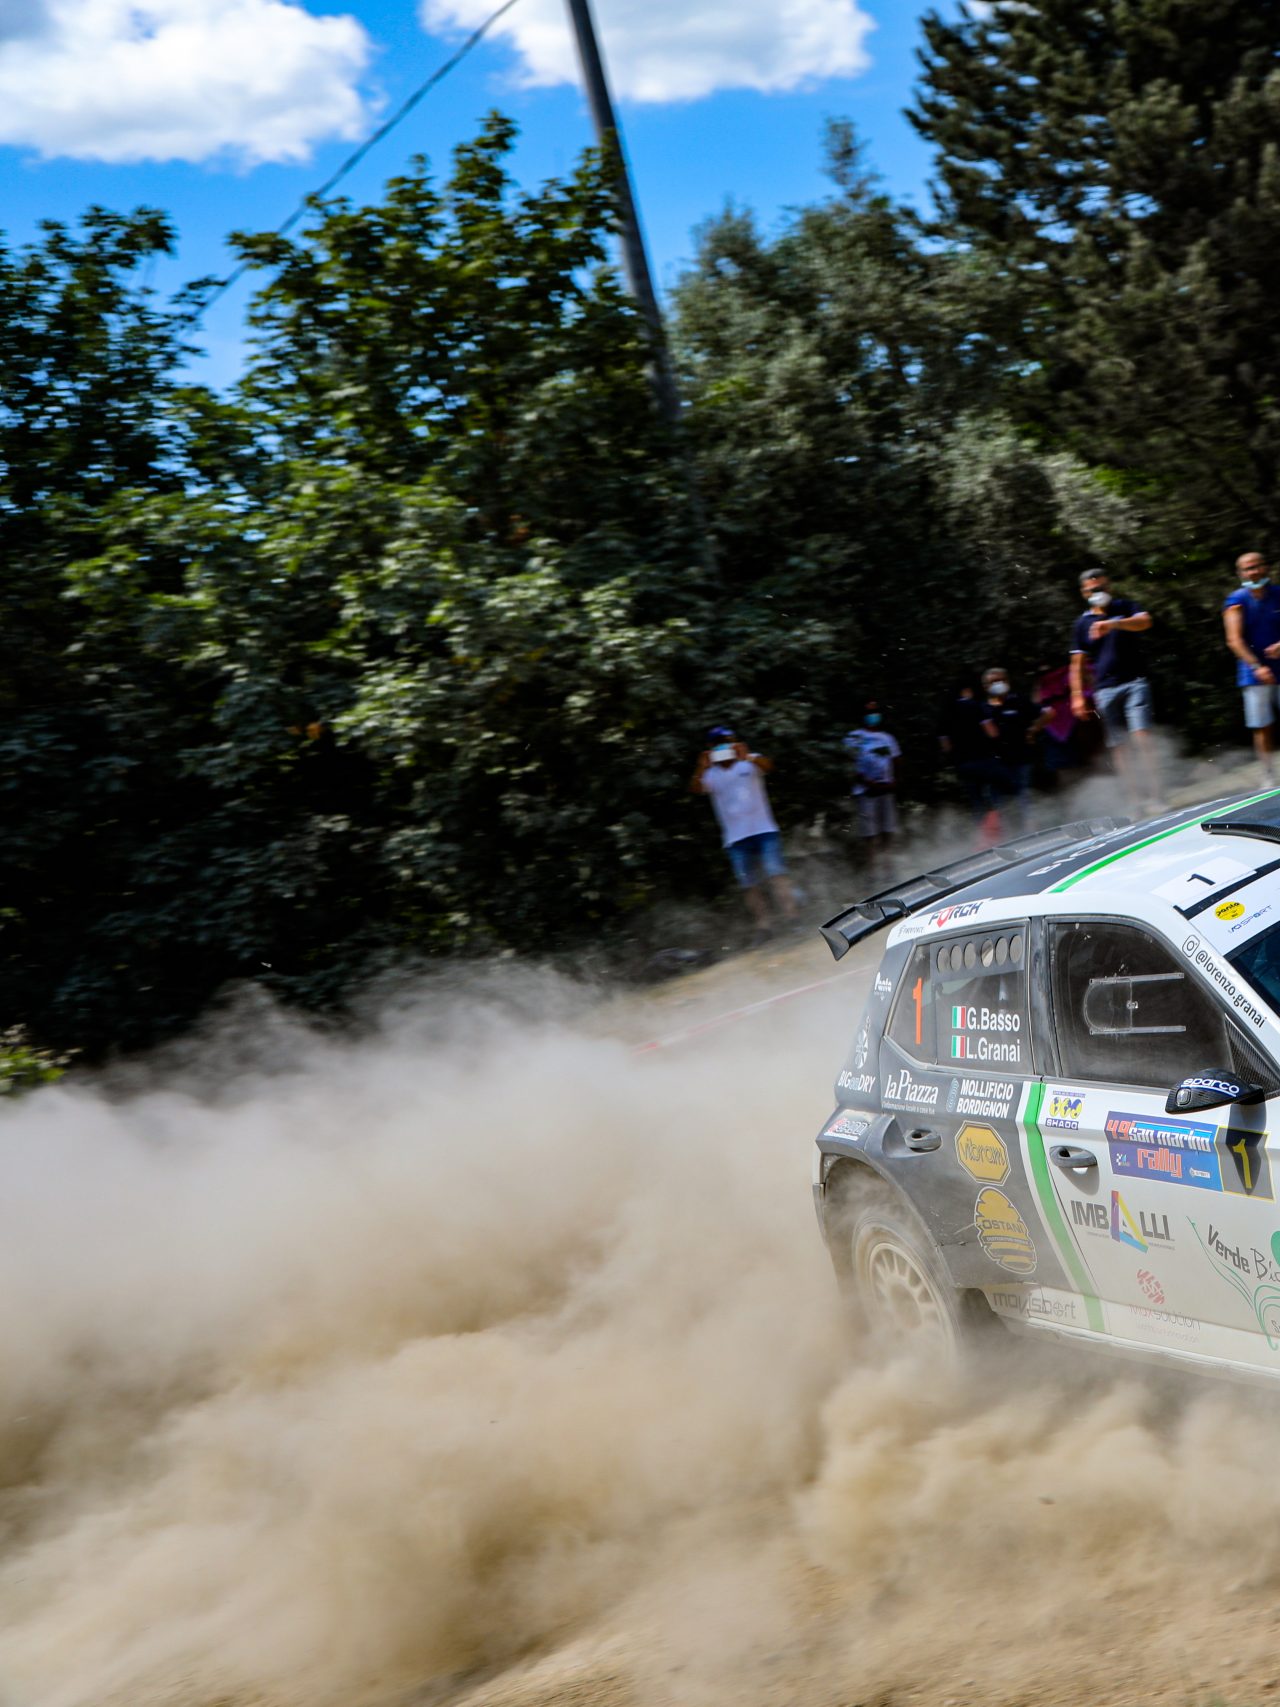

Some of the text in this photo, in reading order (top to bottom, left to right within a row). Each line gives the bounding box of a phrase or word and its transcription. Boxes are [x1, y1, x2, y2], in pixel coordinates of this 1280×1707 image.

[1187, 873, 1215, 886] 1
[1195, 950, 1268, 1028] @lorenzo.granai
[912, 977, 923, 1045] 1
[967, 1007, 1021, 1032] G.Basso
[967, 1037, 1021, 1062] L.Granai
[961, 1079, 1014, 1100] MOLLIFICIO
[1184, 1078, 1240, 1094] sparco
[957, 1098, 1009, 1118] BORDIGNON
[1157, 1130, 1211, 1152] marino
[1137, 1148, 1182, 1178] rally
[1232, 1138, 1253, 1189] 1
[1207, 1224, 1250, 1274] Verde
